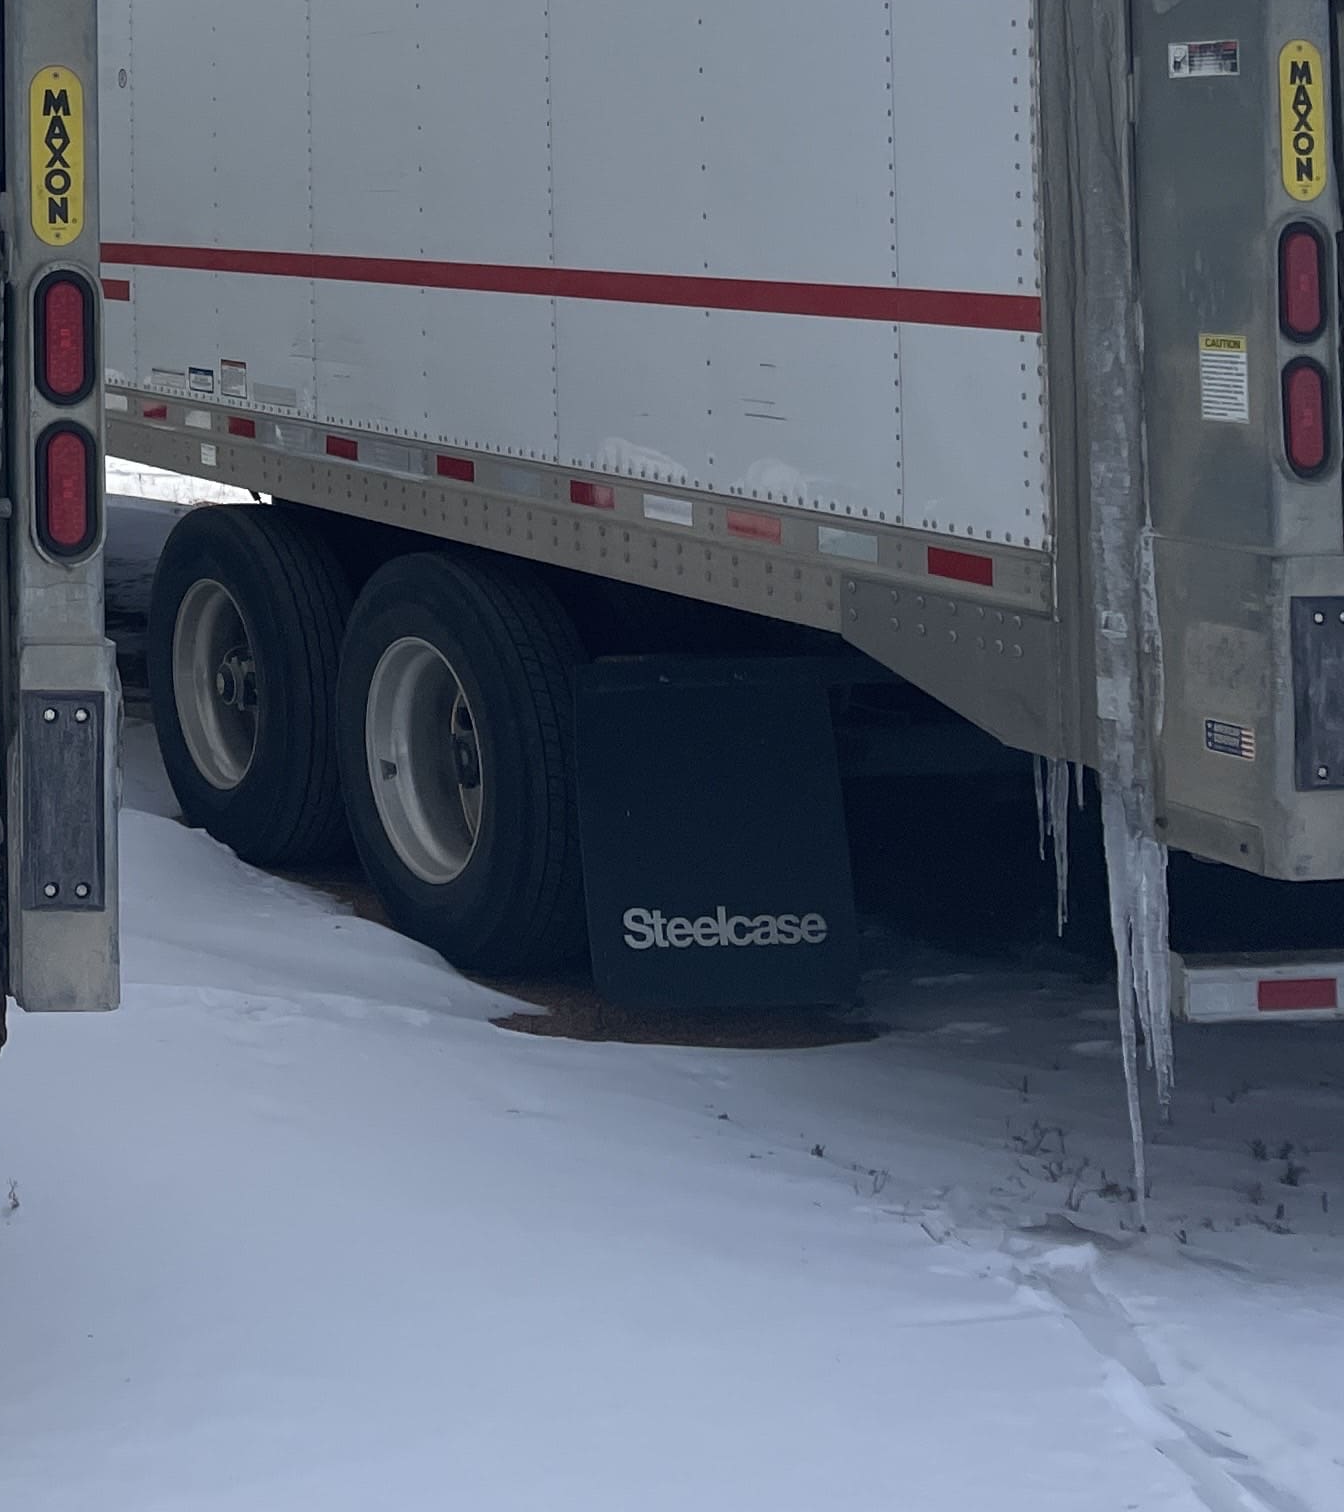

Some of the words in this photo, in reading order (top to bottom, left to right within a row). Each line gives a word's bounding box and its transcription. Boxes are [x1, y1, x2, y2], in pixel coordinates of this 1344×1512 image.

[42, 89, 71, 224] MAXON
[1290, 60, 1315, 181] MAXON
[622, 905, 828, 950] Steelcase
